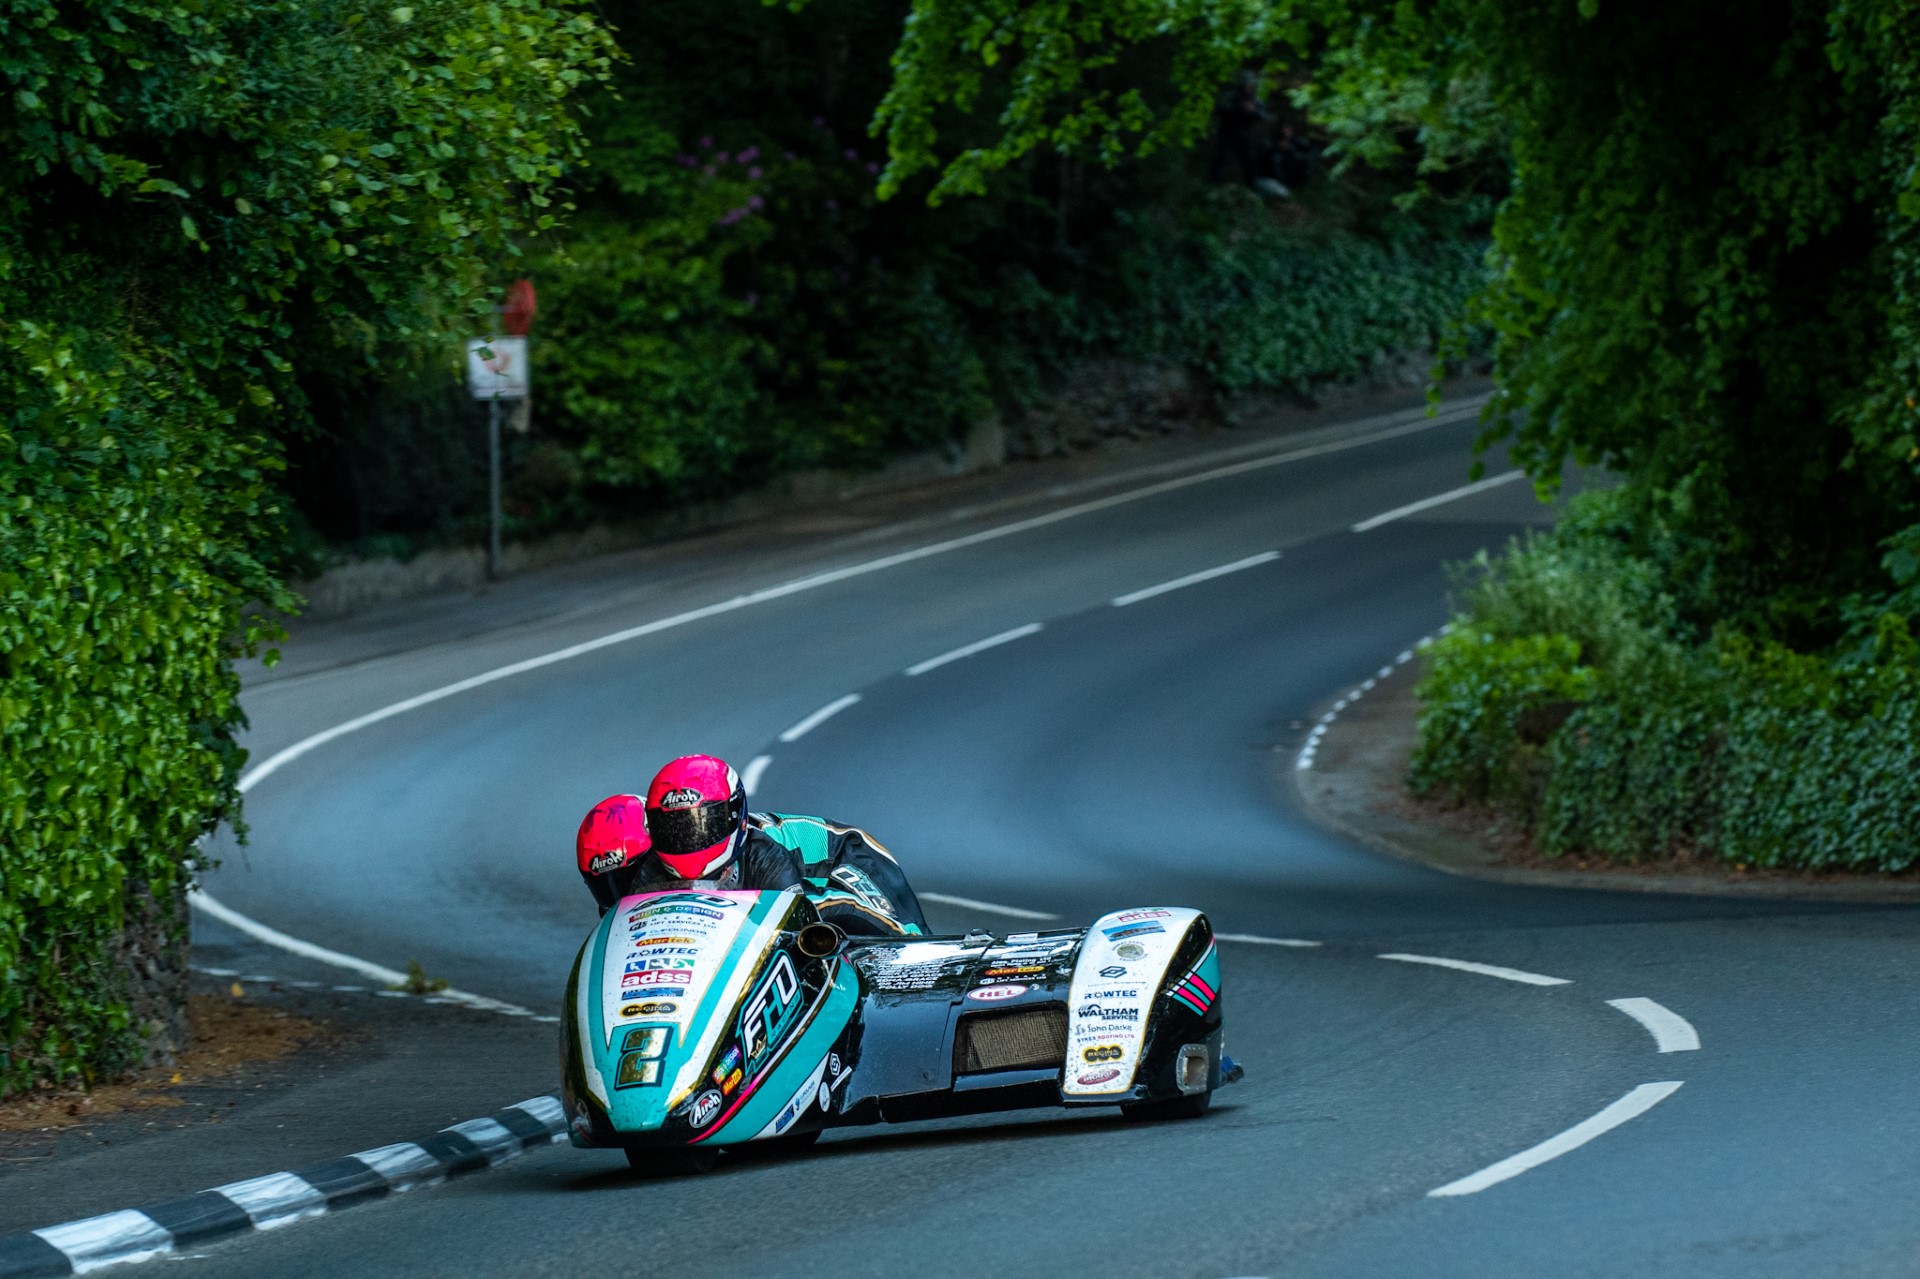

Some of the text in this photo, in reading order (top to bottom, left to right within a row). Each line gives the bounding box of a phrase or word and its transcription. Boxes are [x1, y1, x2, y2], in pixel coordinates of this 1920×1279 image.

[662, 789, 698, 806] Airoh
[591, 852, 623, 870] Airoh
[675, 906, 721, 918] DESIGN
[622, 970, 690, 987] adss
[979, 989, 1017, 998] HEL
[1078, 1007, 1139, 1018] WALTHAM
[614, 1026, 674, 1091] 2
[693, 1093, 721, 1124] Airoh
